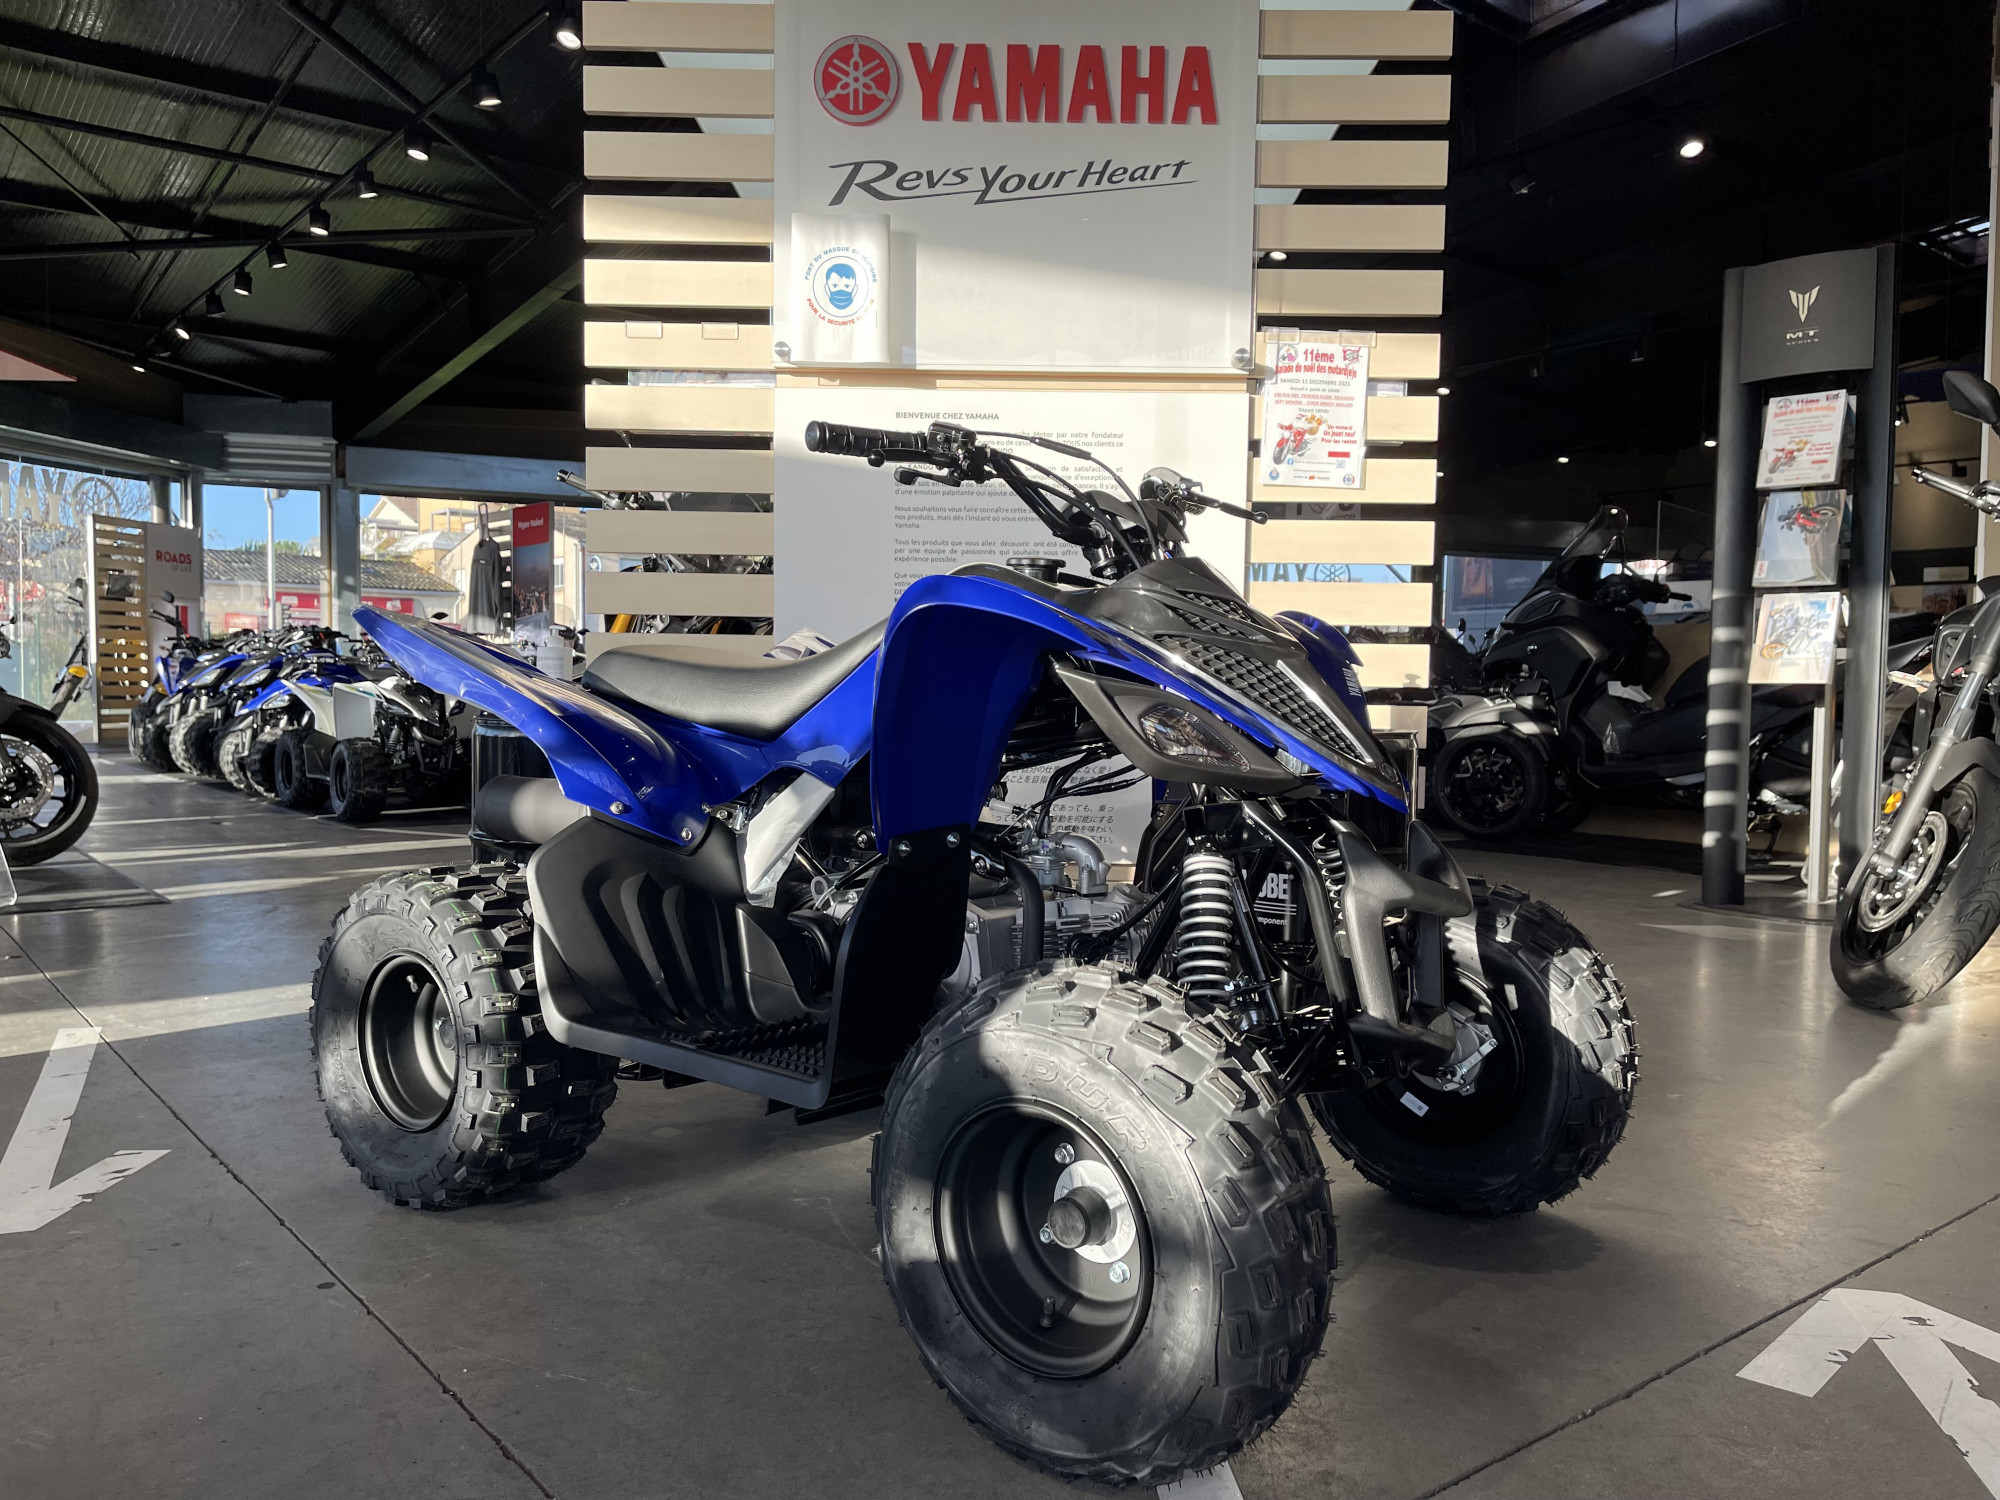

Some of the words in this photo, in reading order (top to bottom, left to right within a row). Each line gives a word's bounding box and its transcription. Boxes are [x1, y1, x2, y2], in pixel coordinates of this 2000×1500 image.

[907, 42, 1219, 125] YAMAHA
[828, 159, 974, 206] Revs
[974, 163, 1080, 205] Your
[1078, 158, 1192, 190] Heart
[804, 262, 815, 281] PORT
[813, 253, 823, 263] DU
[823, 246, 850, 256] MASQUE
[806, 298, 819, 315] POUR
[818, 313, 826, 321] LA
[1303, 348, 1335, 363] 11ème
[1316, 363, 1327, 374] des
[895, 411, 941, 420] BIENVENUE
[942, 412, 963, 420] CHEZ
[965, 412, 1000, 420] YAMAHA
[1056, 432, 1068, 440] par
[1070, 431, 1089, 439] notre
[1091, 431, 1124, 439] fondateur
[894, 488, 913, 496] d'une
[913, 488, 941, 496] émotion
[941, 488, 976, 497] palpitante
[975, 489, 986, 497] qui
[987, 489, 1008, 498] ajoute
[912, 505, 947, 513] souhaitons
[963, 505, 978, 513] faire
[979, 506, 1010, 514] connaître
[907, 513, 936, 522] produits,
[952, 513, 965, 521] dès
[965, 514, 992, 522] l'instant
[991, 514, 1001, 522] où
[517, 520, 530, 531] Hyper
[894, 521, 921, 529] Yamaha.
[894, 538, 910, 546] Tous
[922, 538, 950, 547] produits
[950, 540, 964, 548] que
[981, 539, 996, 547] allez
[1000, 540, 1030, 548] découvrir
[894, 547, 905, 555] par
[924, 547, 947, 555] équipe
[949, 547, 958, 555] de
[961, 547, 996, 556] passionnés
[1000, 548, 1010, 556] qui
[1013, 548, 1040, 556] souhaite
[155, 550, 192, 565] ROADS
[894, 555, 929, 563] expérience
[1341, 667, 1362, 697] YAMAHA
